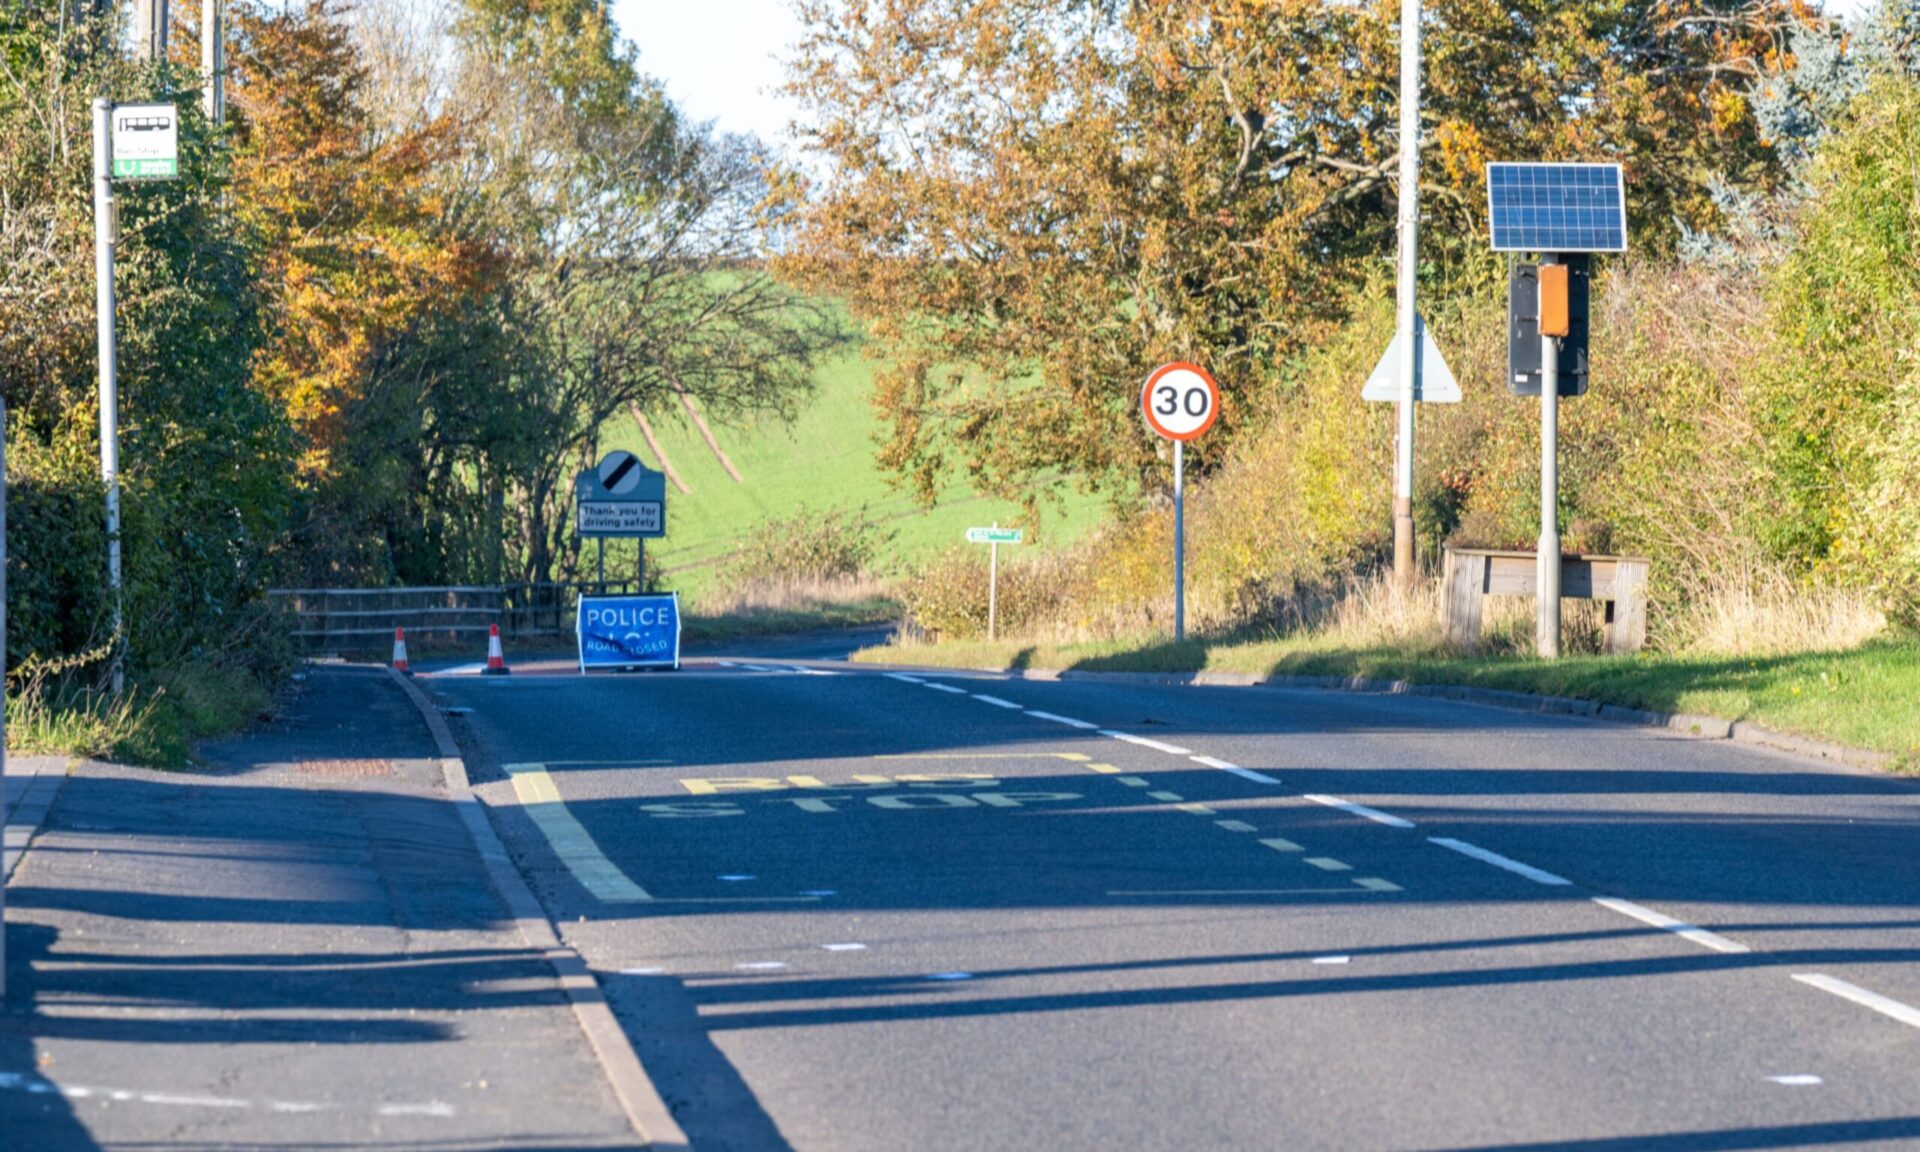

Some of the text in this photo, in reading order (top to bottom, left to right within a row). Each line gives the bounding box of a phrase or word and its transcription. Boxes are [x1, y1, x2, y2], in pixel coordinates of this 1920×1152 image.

[1156, 386, 1208, 417] 30
[584, 506, 656, 516] Thank you for
[583, 518, 656, 528] driving safely
[587, 607, 669, 627] POLICE
[587, 640, 620, 653] ROAD
[679, 773, 1001, 795] BUS
[639, 792, 1085, 818] STOP
